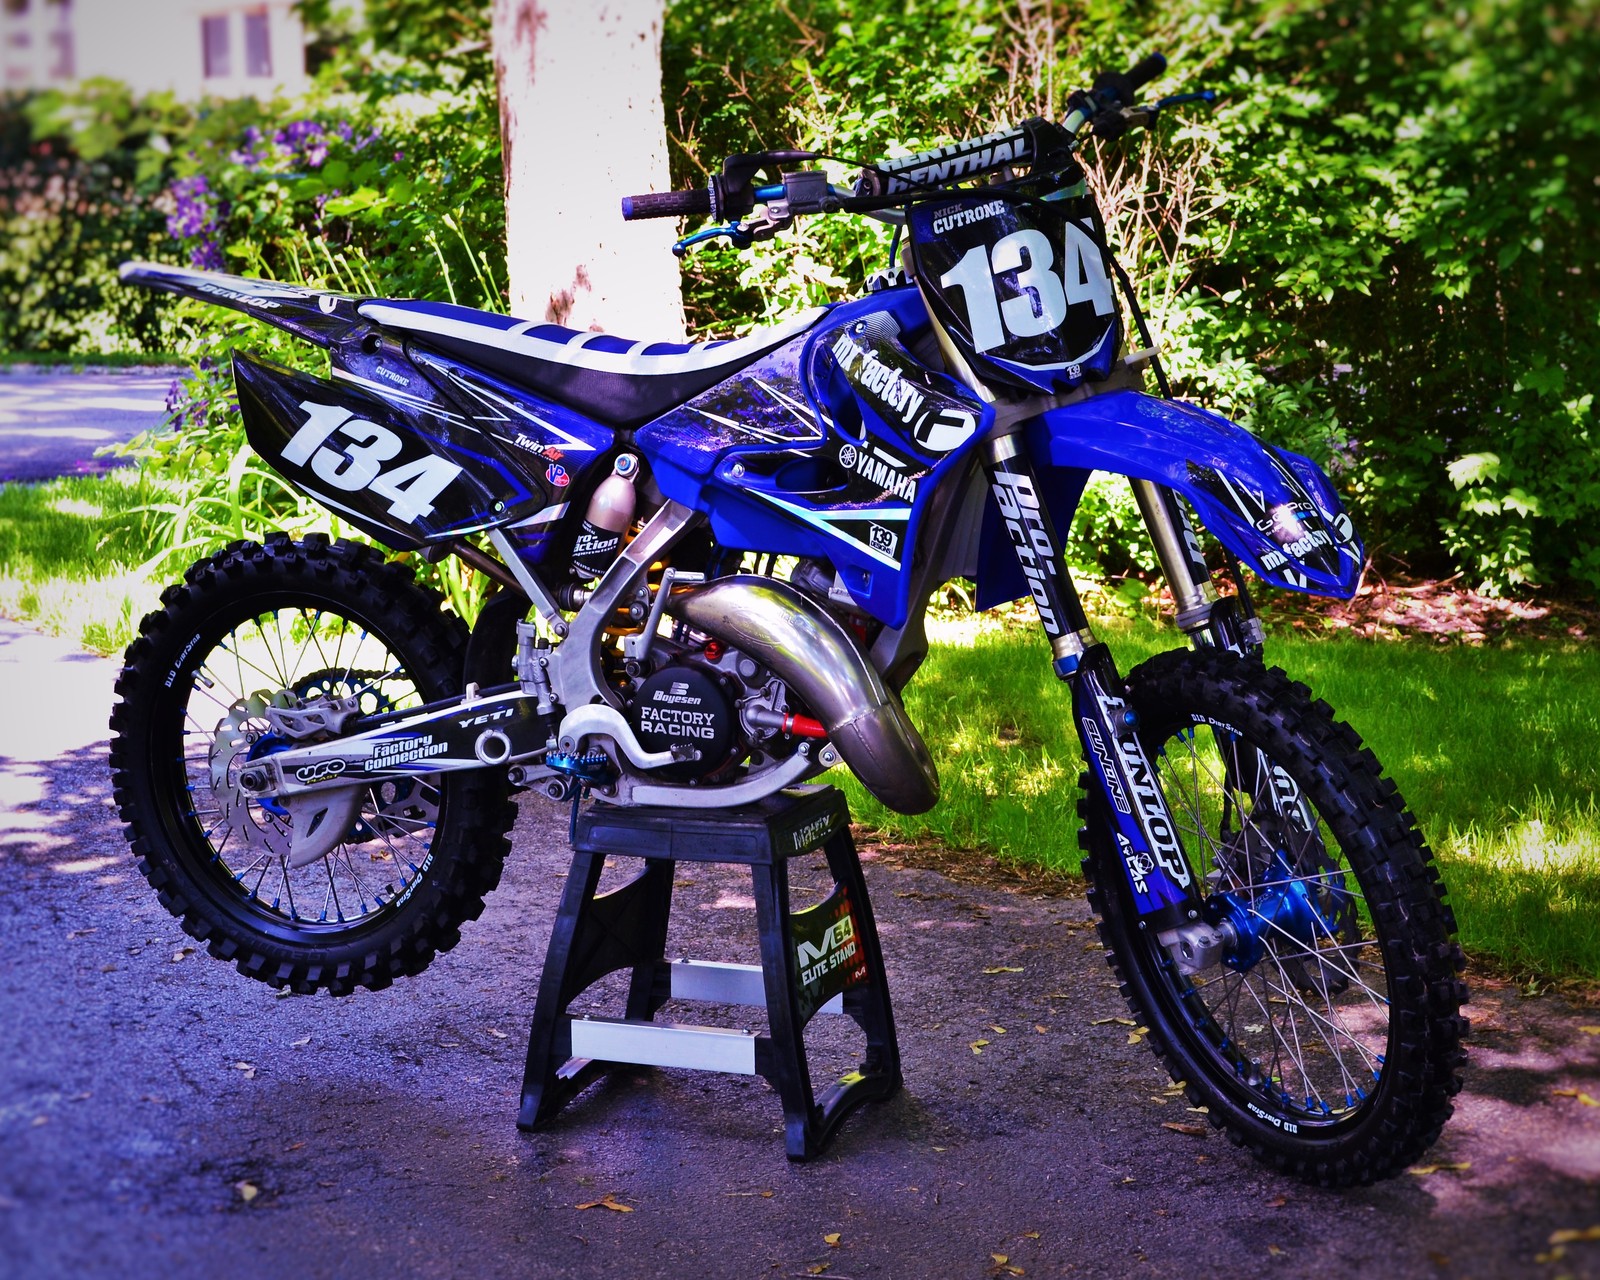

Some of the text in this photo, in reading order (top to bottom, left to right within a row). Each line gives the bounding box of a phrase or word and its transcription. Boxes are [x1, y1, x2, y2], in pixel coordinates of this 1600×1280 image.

[887, 138, 1031, 195] RENTHAL
[933, 203, 963, 220] NICK
[933, 200, 1005, 235] CUTRONE
[197, 283, 281, 309] DUNLOP
[940, 217, 1115, 353] 134
[375, 365, 410, 387] CUTRONE
[280, 400, 463, 525] 134
[857, 451, 917, 503] YAMAHA
[994, 471, 1056, 575] pro-
[1256, 502, 1313, 531] GoPro
[872, 526, 893, 547] 139
[992, 484, 1059, 634] action
[653, 690, 702, 705] Boyesen
[458, 708, 514, 729] YETI
[641, 706, 715, 726] FACTORY
[641, 720, 715, 739] RACING
[374, 735, 433, 758] Factory
[296, 759, 346, 781] UFO
[802, 941, 856, 986] ELITE STAND
